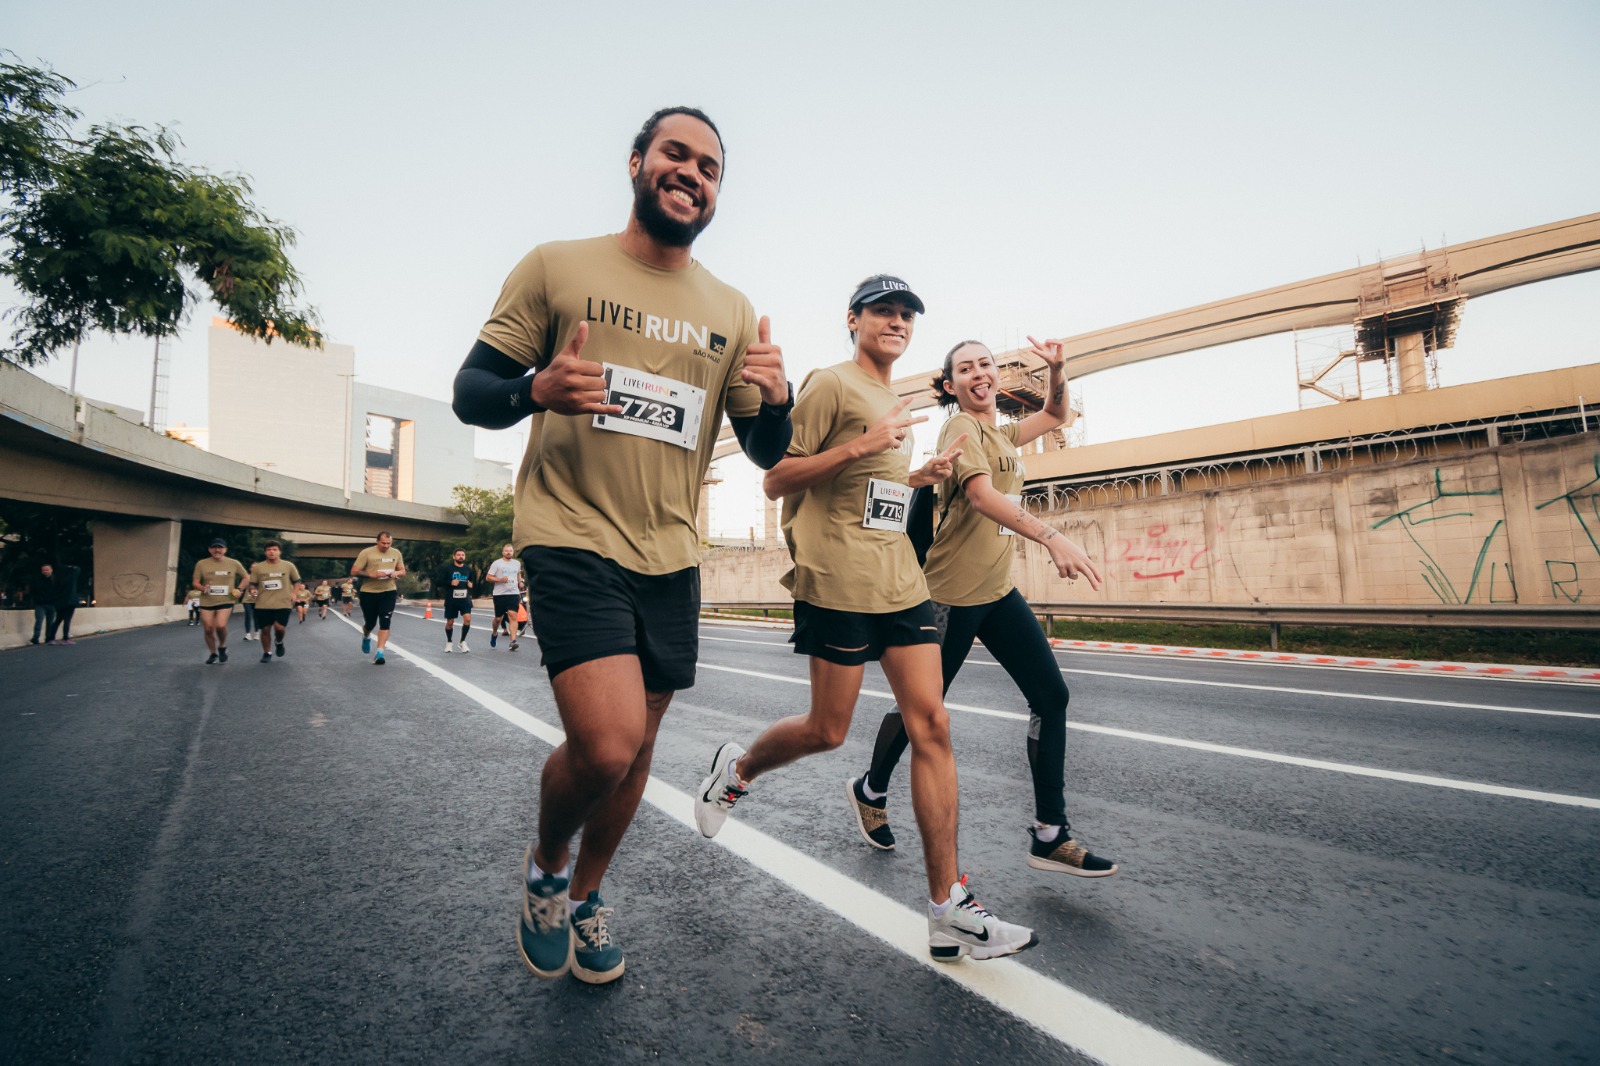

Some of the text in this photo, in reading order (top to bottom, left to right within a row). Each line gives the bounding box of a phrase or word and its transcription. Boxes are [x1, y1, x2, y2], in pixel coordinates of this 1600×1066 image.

[586, 296, 708, 349] LIVE! RUN
[623, 377, 645, 390] LIVE!
[645, 382, 671, 396] RUN
[619, 395, 676, 426] 7723
